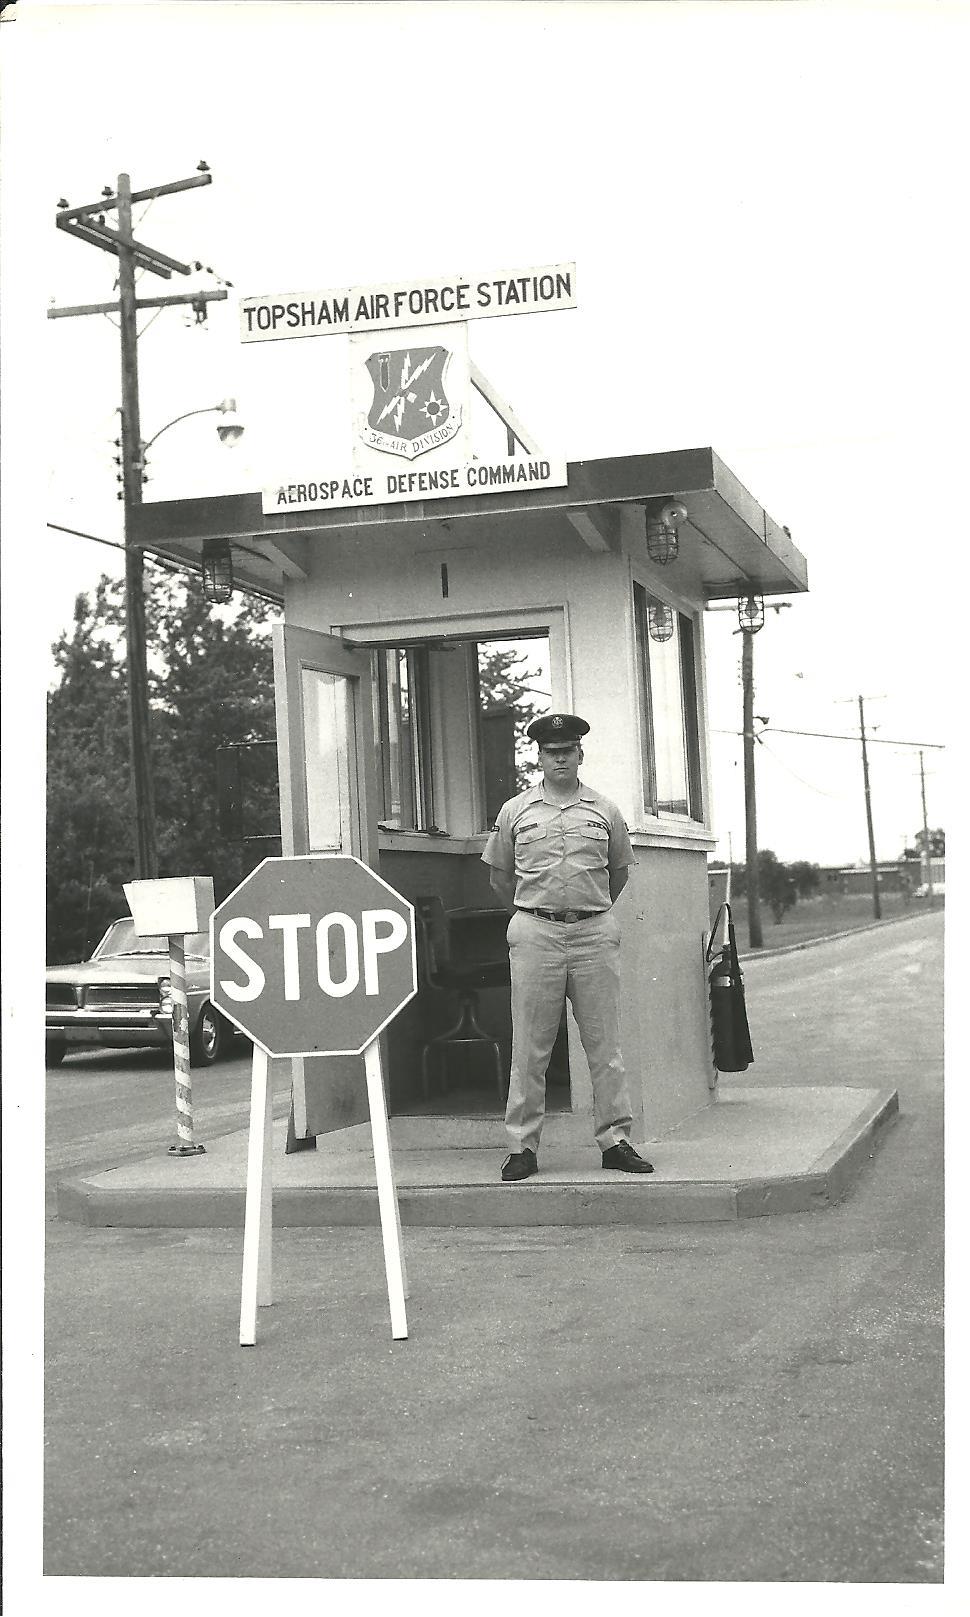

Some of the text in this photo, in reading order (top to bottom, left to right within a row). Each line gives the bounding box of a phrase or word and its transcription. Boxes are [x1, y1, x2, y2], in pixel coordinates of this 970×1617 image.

[243, 272, 572, 332] TOPSHAM AIR FORCE STATION
[412, 424, 453, 452] DIVISION
[276, 460, 551, 505] AEROSPACE DEFENSE COMMAND
[219, 908, 408, 1002] STOP
